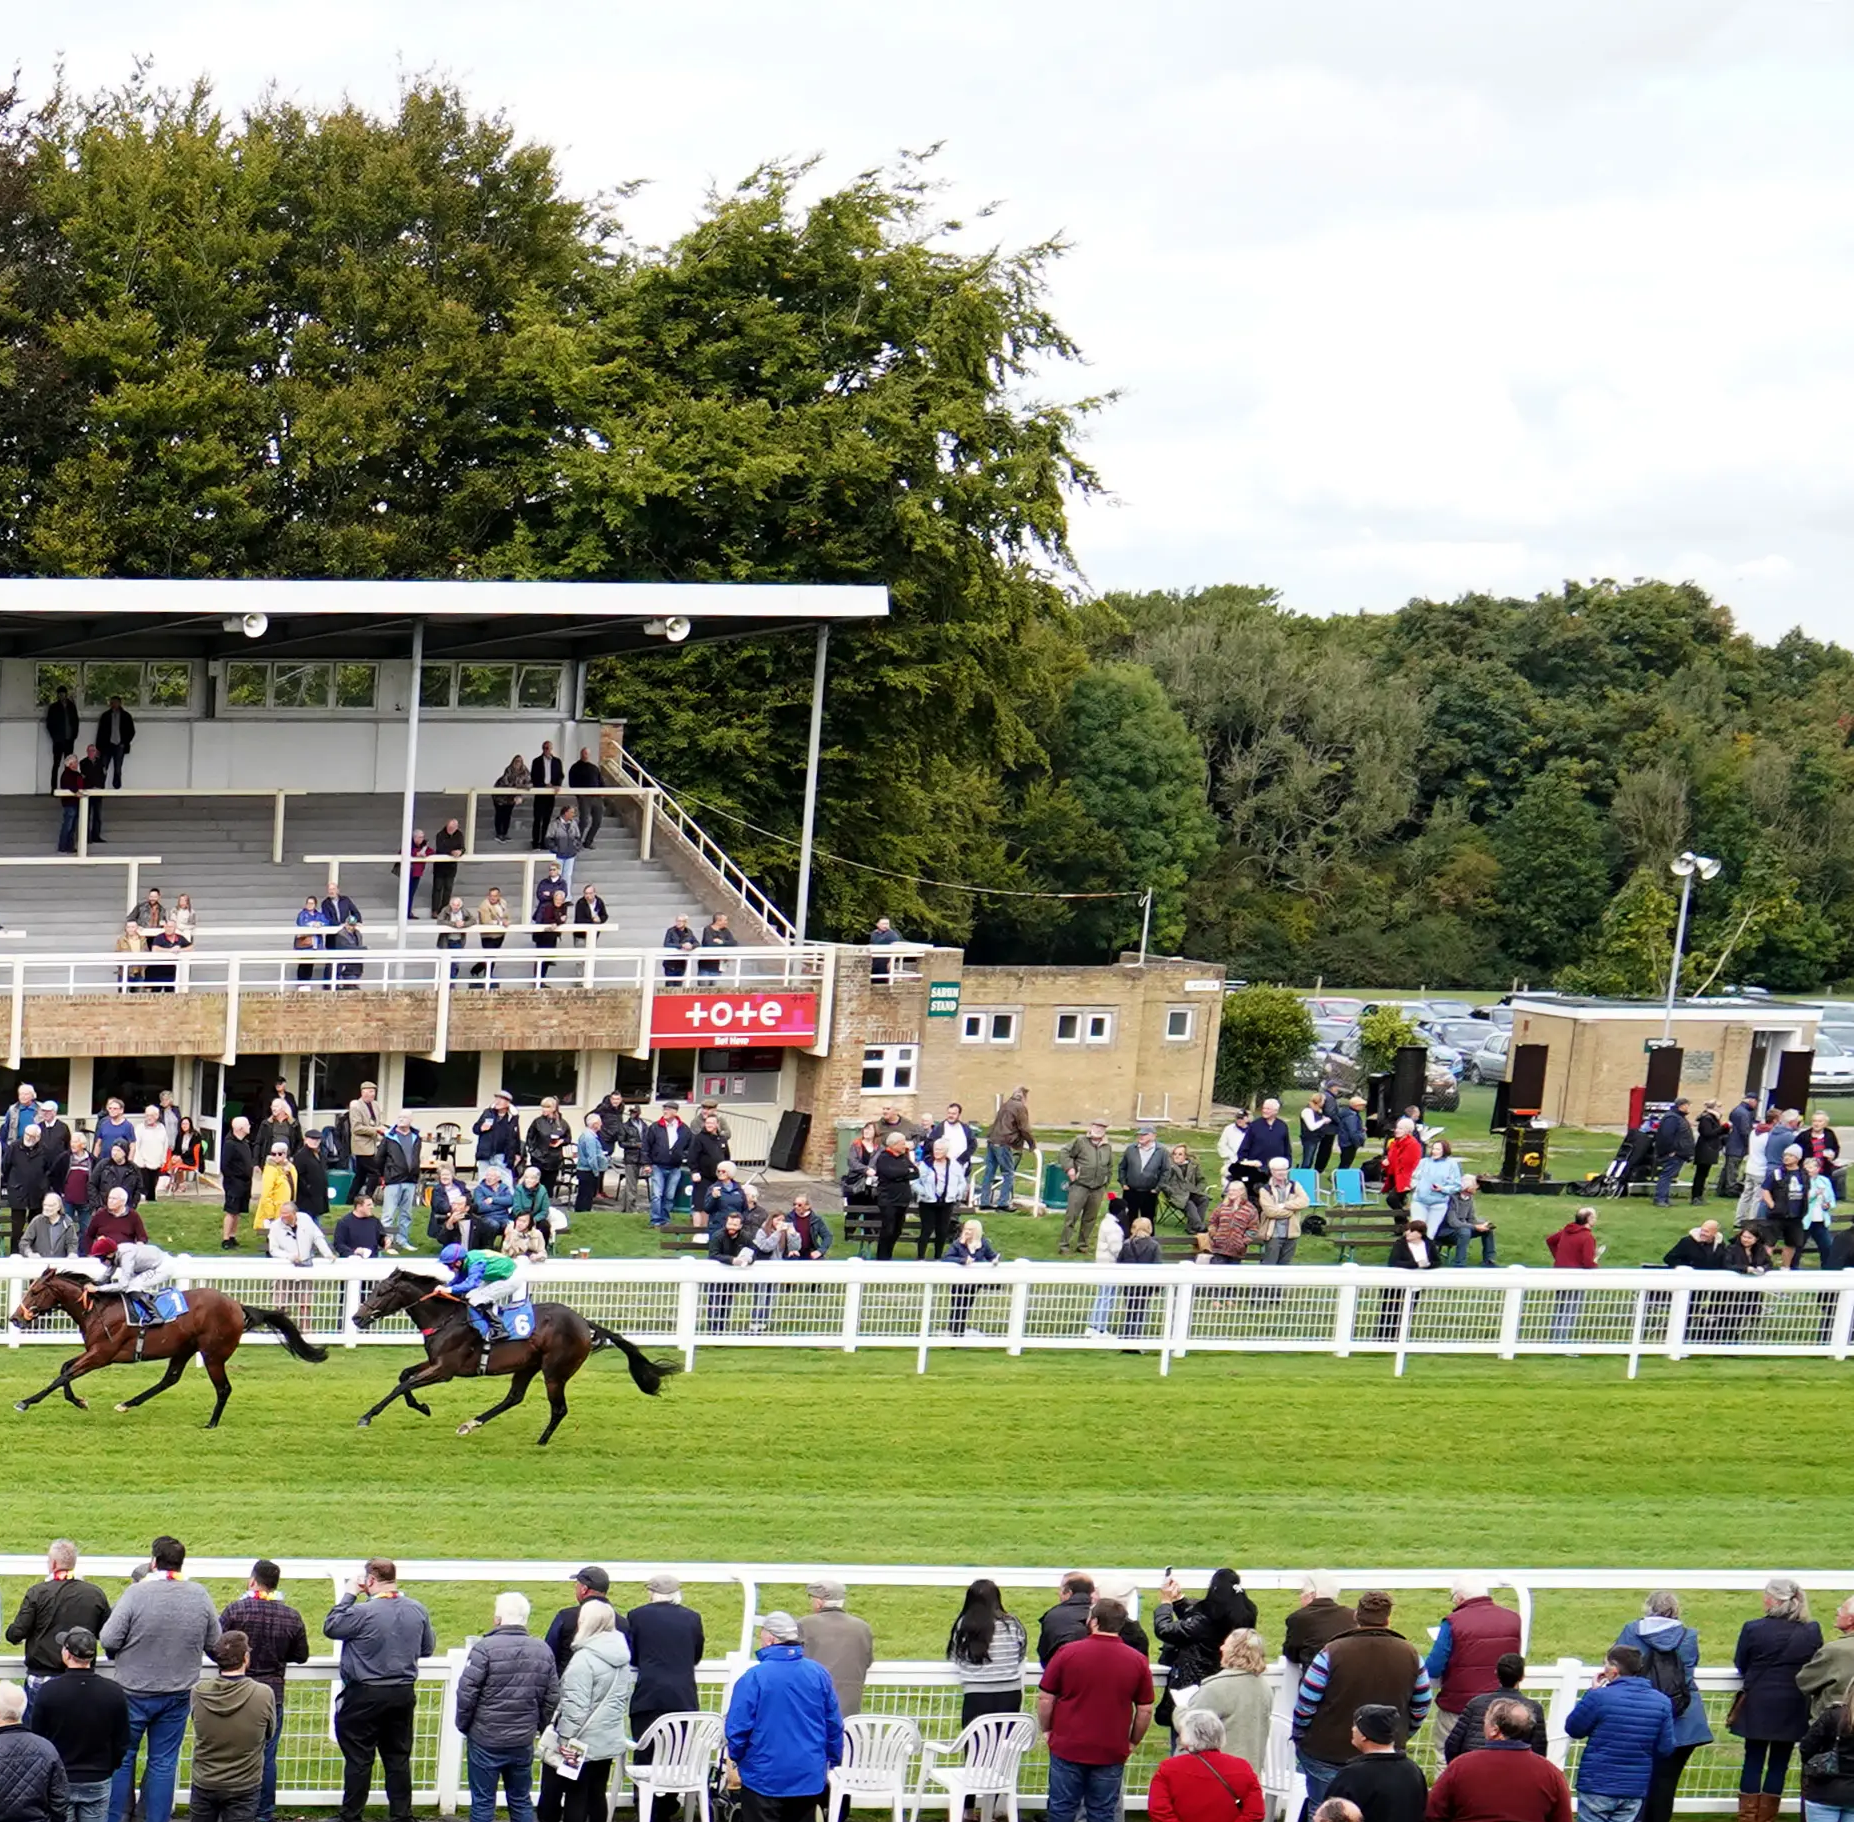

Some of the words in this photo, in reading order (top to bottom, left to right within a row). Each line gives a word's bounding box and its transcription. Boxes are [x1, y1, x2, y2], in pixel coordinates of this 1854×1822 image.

[930, 1000, 957, 1012] STAND
[171, 1292, 183, 1312] 1
[514, 1314, 531, 1336] 6
